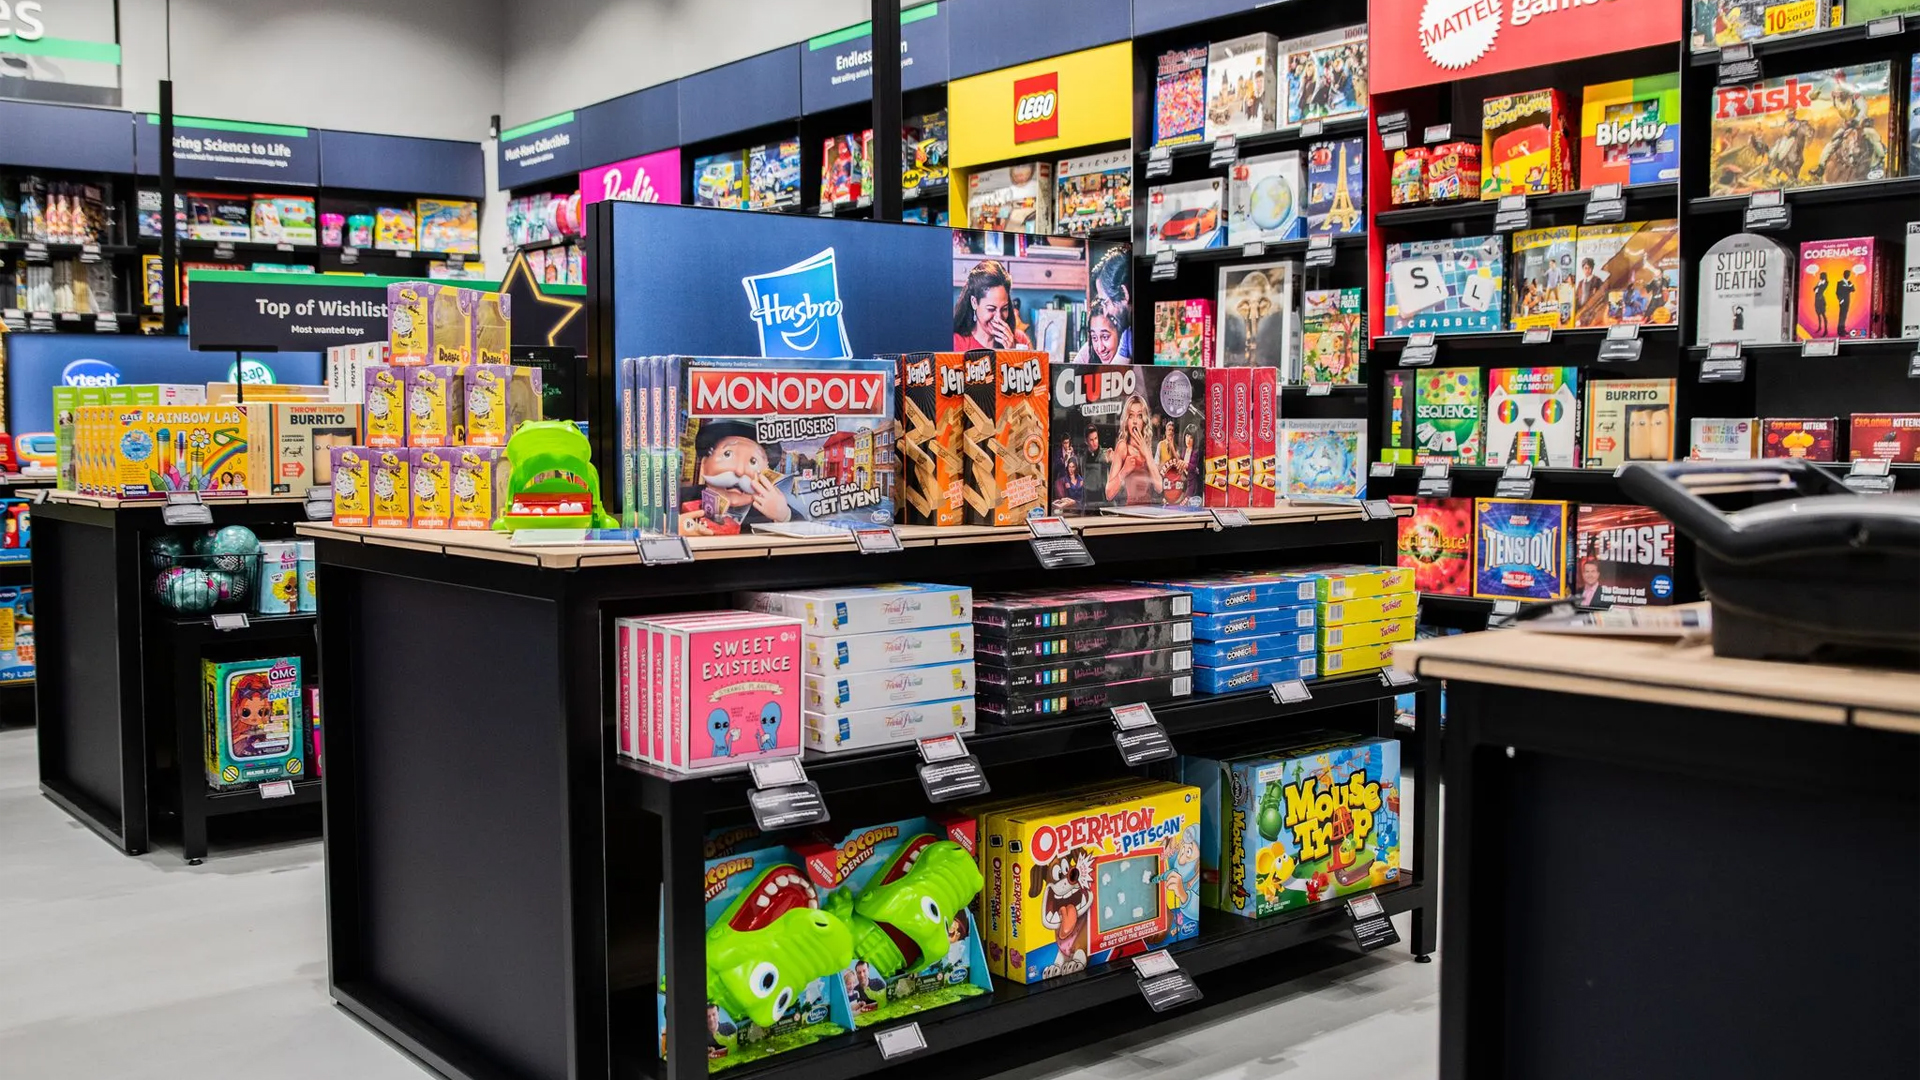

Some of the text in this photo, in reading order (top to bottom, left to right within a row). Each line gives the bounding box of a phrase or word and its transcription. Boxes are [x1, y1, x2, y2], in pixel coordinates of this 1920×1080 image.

[1423, 0, 1500, 47] MATTEL
[1768, 9, 1787, 32] 10
[1786, 8, 1815, 24] SOLD!
[835, 49, 872, 71] Endless
[1016, 92, 1056, 123] LEGO
[1484, 97, 1512, 117] UNO
[1715, 77, 1814, 120] Risk
[1482, 96, 1552, 130] SHOWDOWN
[1595, 120, 1668, 146] Blokus
[203, 138, 292, 158] Science to Life
[1311, 148, 1332, 166] 3D
[1232, 165, 1250, 182] 3D
[1428, 153, 1460, 180] UNO
[1515, 229, 1571, 248] PICTIONARY
[1717, 249, 1767, 271] STUPID
[1804, 246, 1869, 260] CODENAMES
[1410, 266, 1429, 290] S
[1715, 269, 1767, 291] DEATHS
[1471, 284, 1480, 300] L
[256, 299, 388, 320] Top of Wishlist
[753, 292, 842, 328] Hasbro
[291, 324, 365, 337] Most wanted toys
[1396, 316, 1488, 330] SCRABBLE
[907, 358, 931, 385] Jenga
[965, 355, 991, 383] Jenga
[1001, 357, 1042, 394] Jenga
[1517, 374, 1541, 383] GAME
[1541, 373, 1555, 382] OF
[64, 373, 118, 387] vtech
[940, 365, 964, 395] Jen
[1055, 367, 1136, 408] CLUEDO
[1508, 382, 1523, 391] CAT
[696, 375, 881, 411] MONOPOLY
[1605, 390, 1658, 402] BURRITO
[120, 413, 141, 421] GALT
[146, 411, 241, 425] RAINBOW LAB
[290, 414, 345, 425] BURRITO
[1416, 404, 1478, 420] SEQUENCE
[759, 417, 834, 442] SORE LOSERS
[1288, 421, 1358, 430] Ravensburger Puzzle
[1802, 420, 1828, 431] KITTENS
[1701, 434, 1739, 445] UNICORNS
[810, 477, 837, 491] DON'T
[823, 483, 860, 498] GET SAD.
[810, 487, 880, 518] GET EVEN!
[1484, 526, 1553, 577] TENSION
[1578, 531, 1588, 559] THE
[1598, 524, 1670, 567] CHASE
[1381, 575, 1402, 589] Twister
[1225, 593, 1250, 606] CONNECT
[1381, 599, 1403, 614] Twister
[1035, 611, 1068, 628] LIFE
[1224, 620, 1250, 634] CONNECT
[1380, 623, 1401, 637] Twister
[712, 635, 776, 659] SWEET
[1035, 639, 1068, 657] LIFE
[1227, 647, 1252, 660] CONNECT
[270, 667, 297, 681] OMG
[702, 655, 791, 681] EXISTENCE
[1035, 668, 1068, 685] LIFE
[1228, 673, 1253, 687] CONNECT
[269, 689, 299, 700] DANCE
[1035, 696, 1068, 712] LIFE
[1284, 767, 1382, 828] Mouse
[1031, 807, 1155, 867] OPERATION
[834, 825, 898, 869] ROCODILE
[840, 847, 875, 878] DENTIST
[993, 856, 1002, 919] OPERATION
[1012, 862, 1022, 925] OPERATION
[1124, 927, 1133, 935] THE
